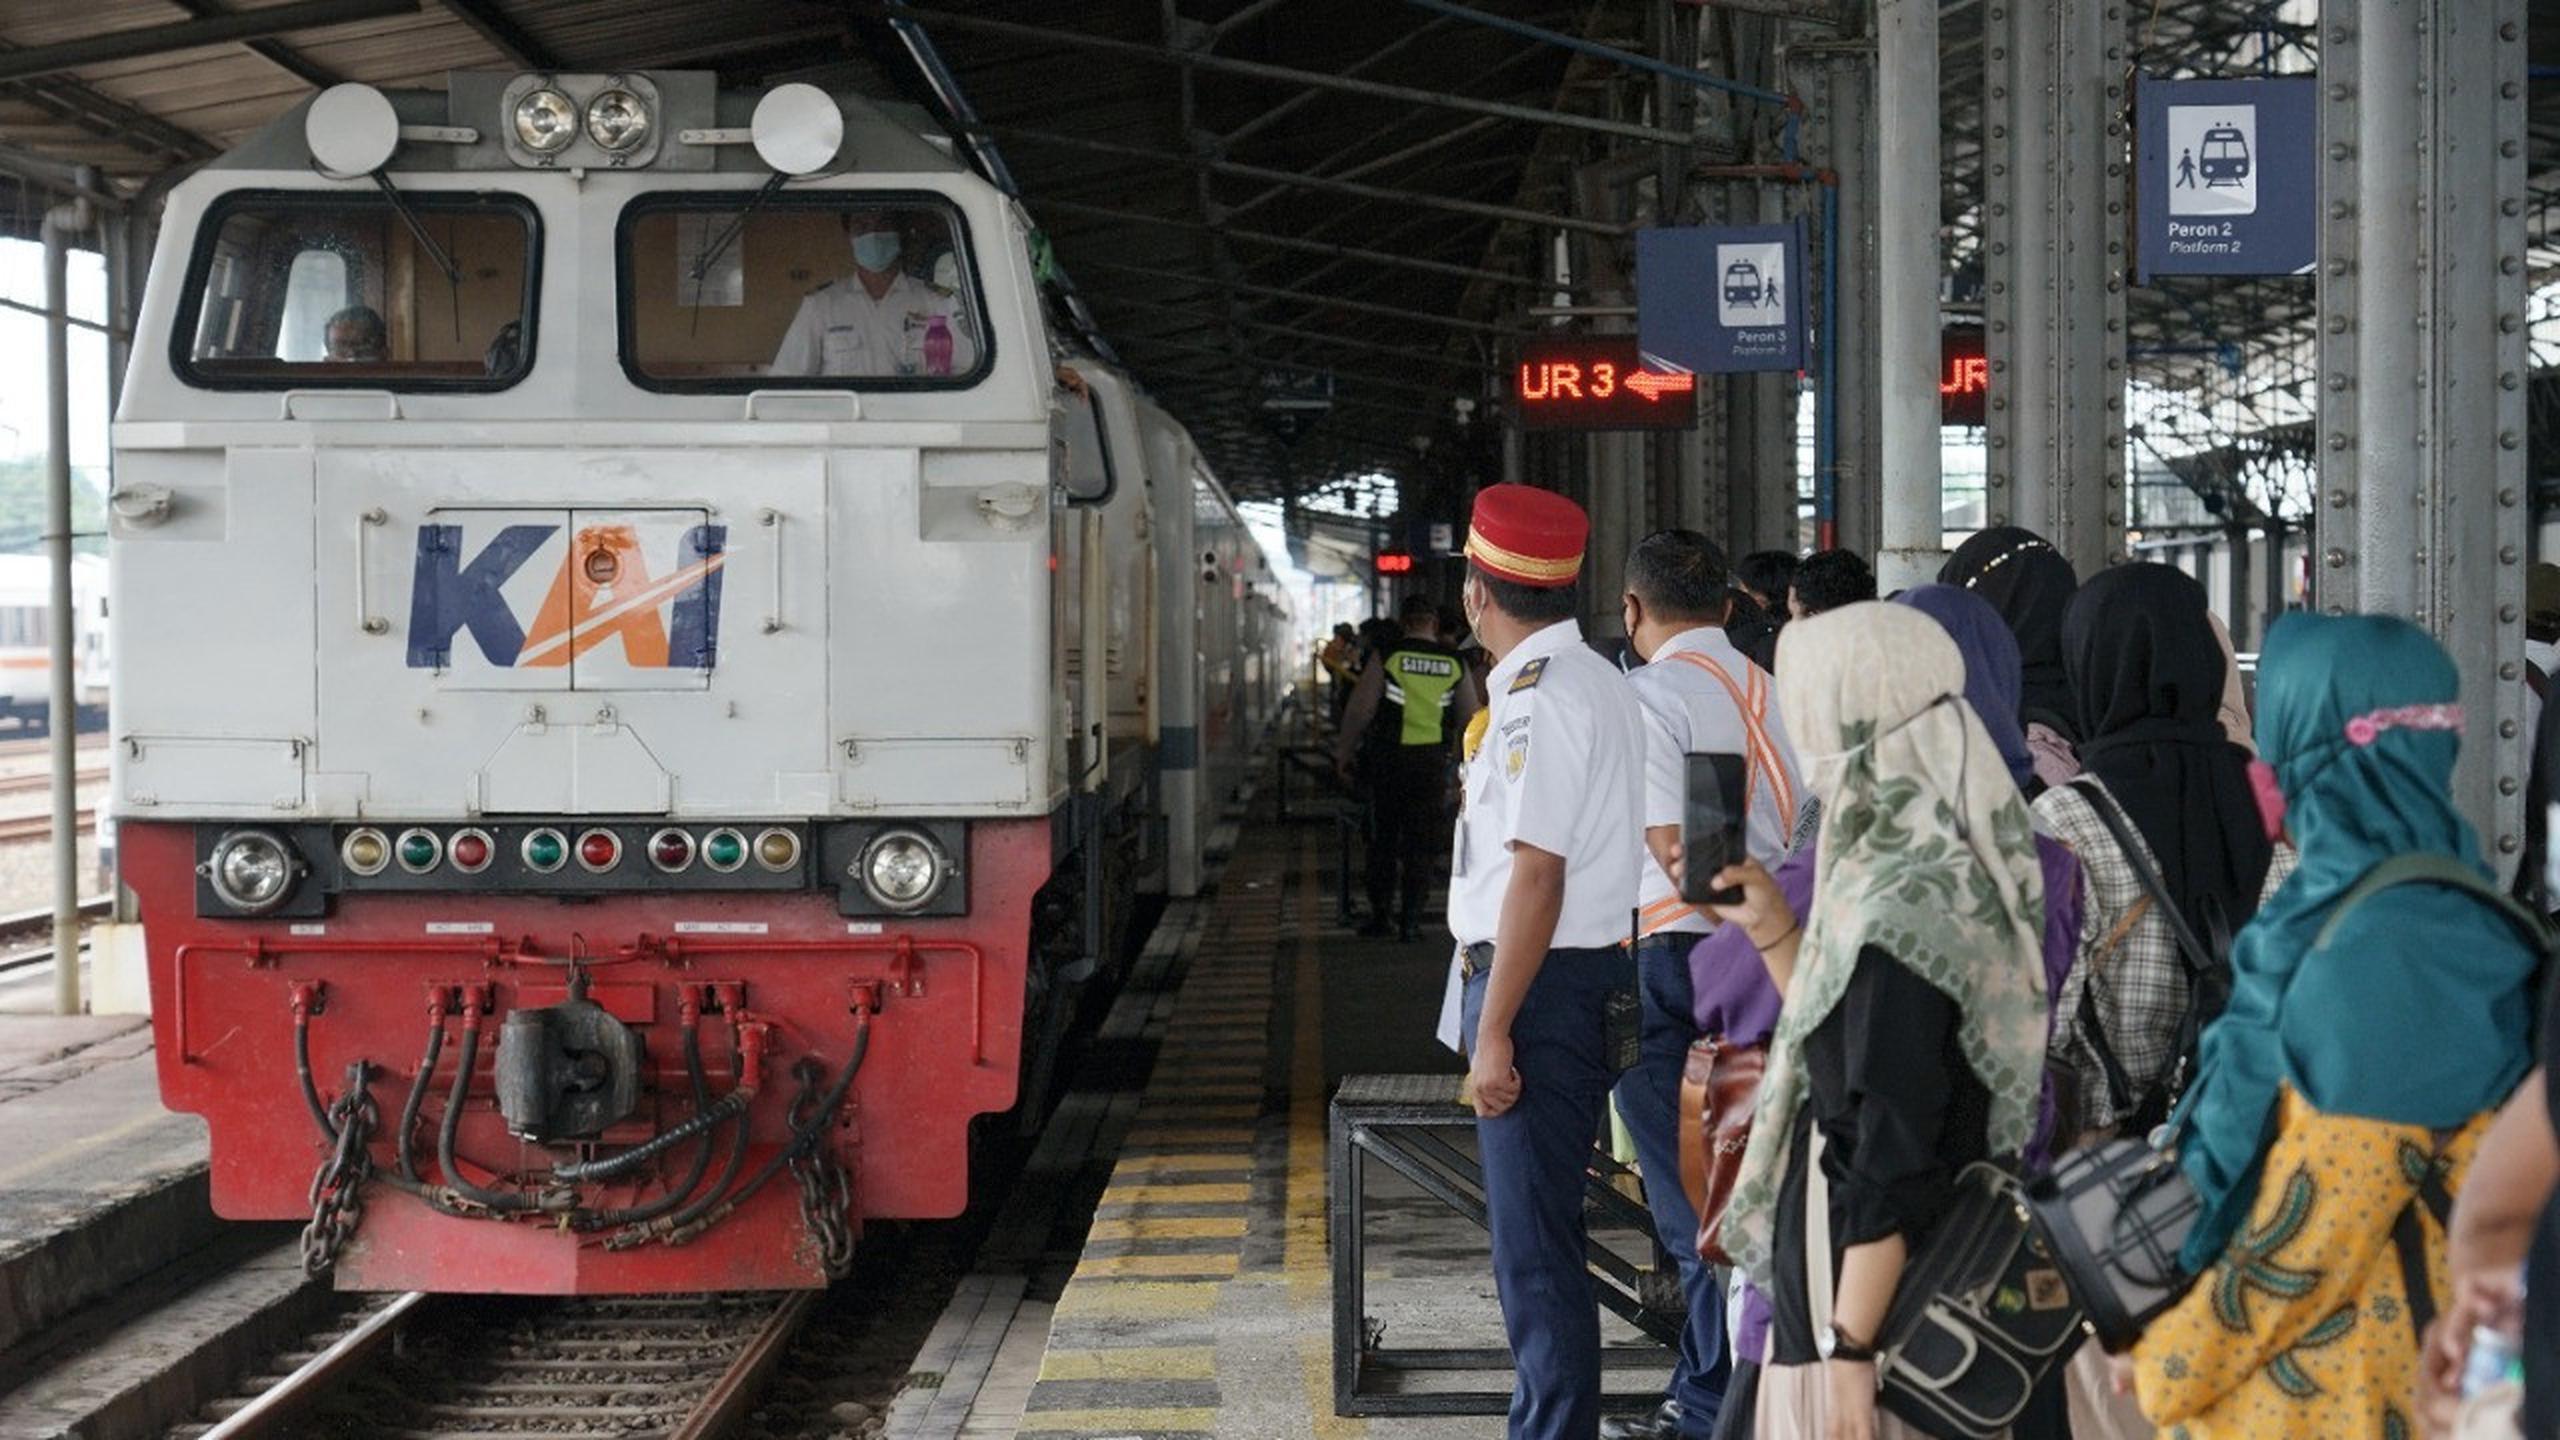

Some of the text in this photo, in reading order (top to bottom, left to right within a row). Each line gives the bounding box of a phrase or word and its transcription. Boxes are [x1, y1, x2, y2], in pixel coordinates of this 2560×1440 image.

[2168, 221, 2233, 237] Peron 2
[2169, 240, 2242, 254] Platform 2
[1738, 330, 1787, 342] Peron 3
[1522, 363, 1615, 399] UR 3
[406, 525, 728, 668] KAI
[1402, 656, 1452, 675] SATPAM
